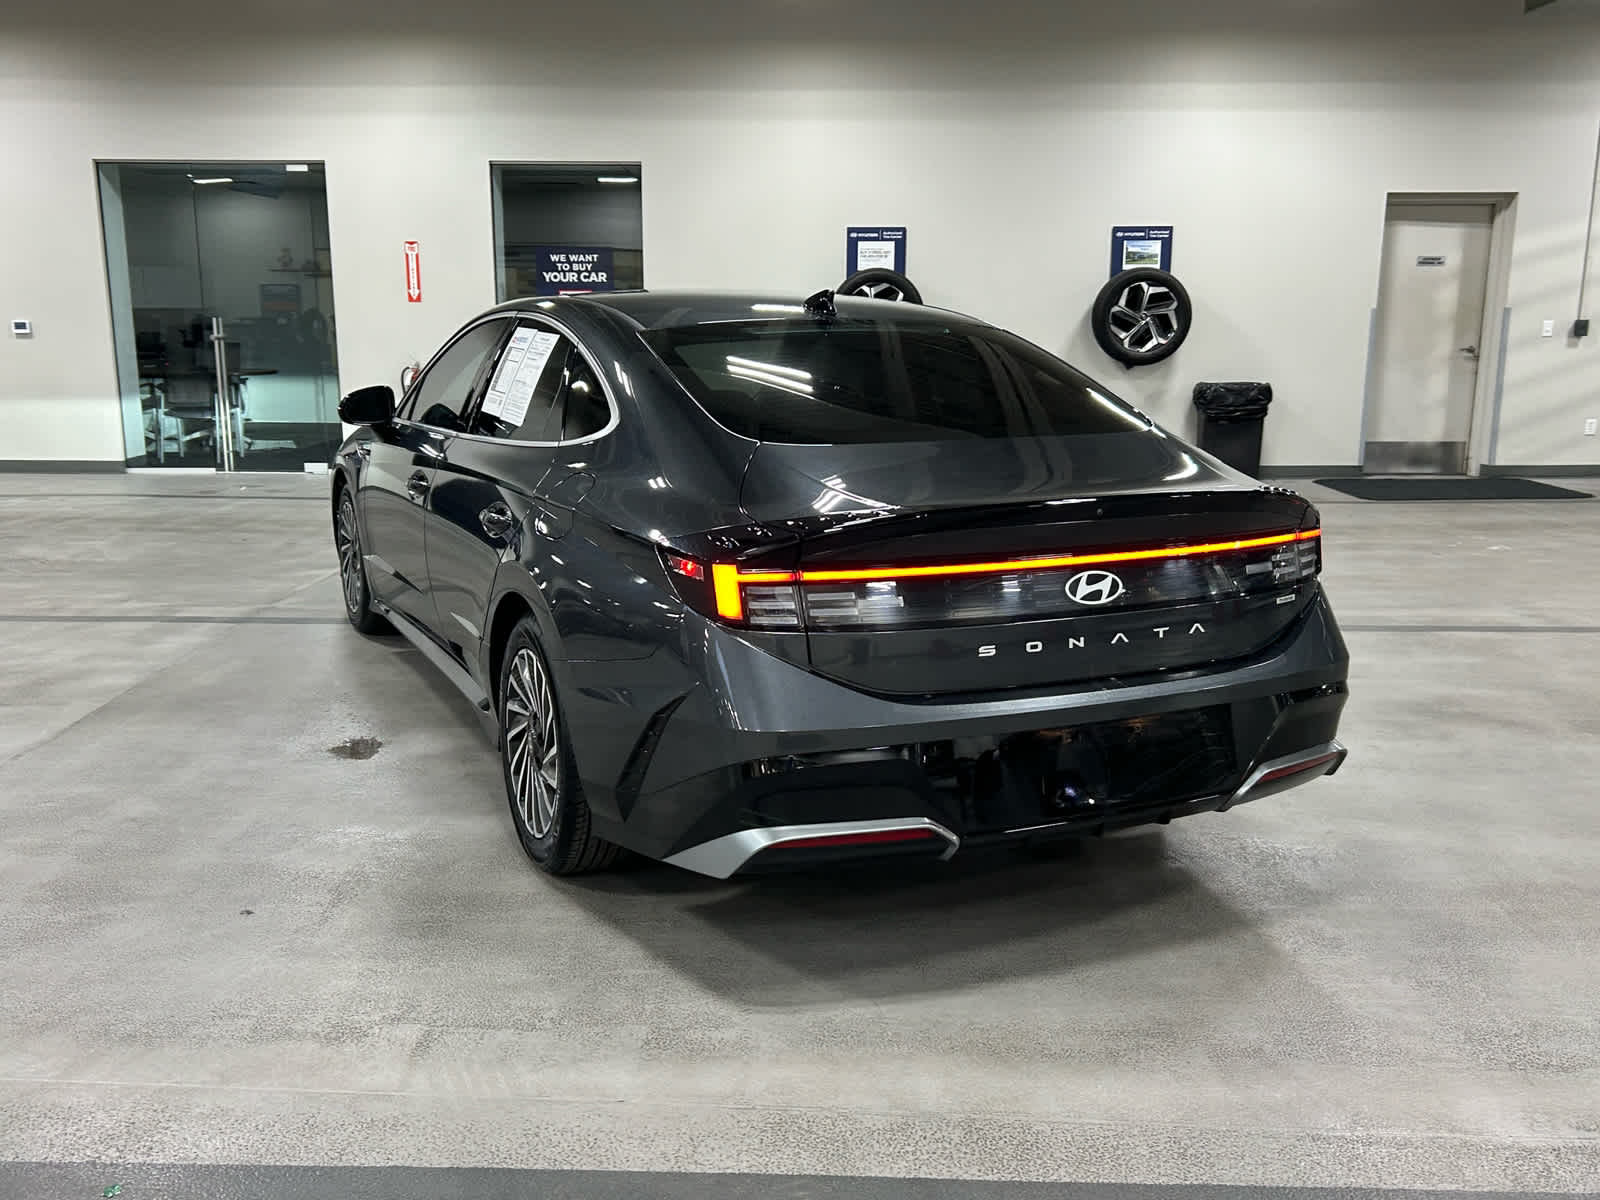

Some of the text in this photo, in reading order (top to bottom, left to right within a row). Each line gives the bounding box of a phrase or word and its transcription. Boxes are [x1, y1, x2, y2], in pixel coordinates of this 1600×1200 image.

[549, 254, 599, 262] WE WANT
[556, 263, 593, 271] TO BUY
[542, 271, 608, 282] YOUR CAR
[978, 623, 1206, 657] SONATA
